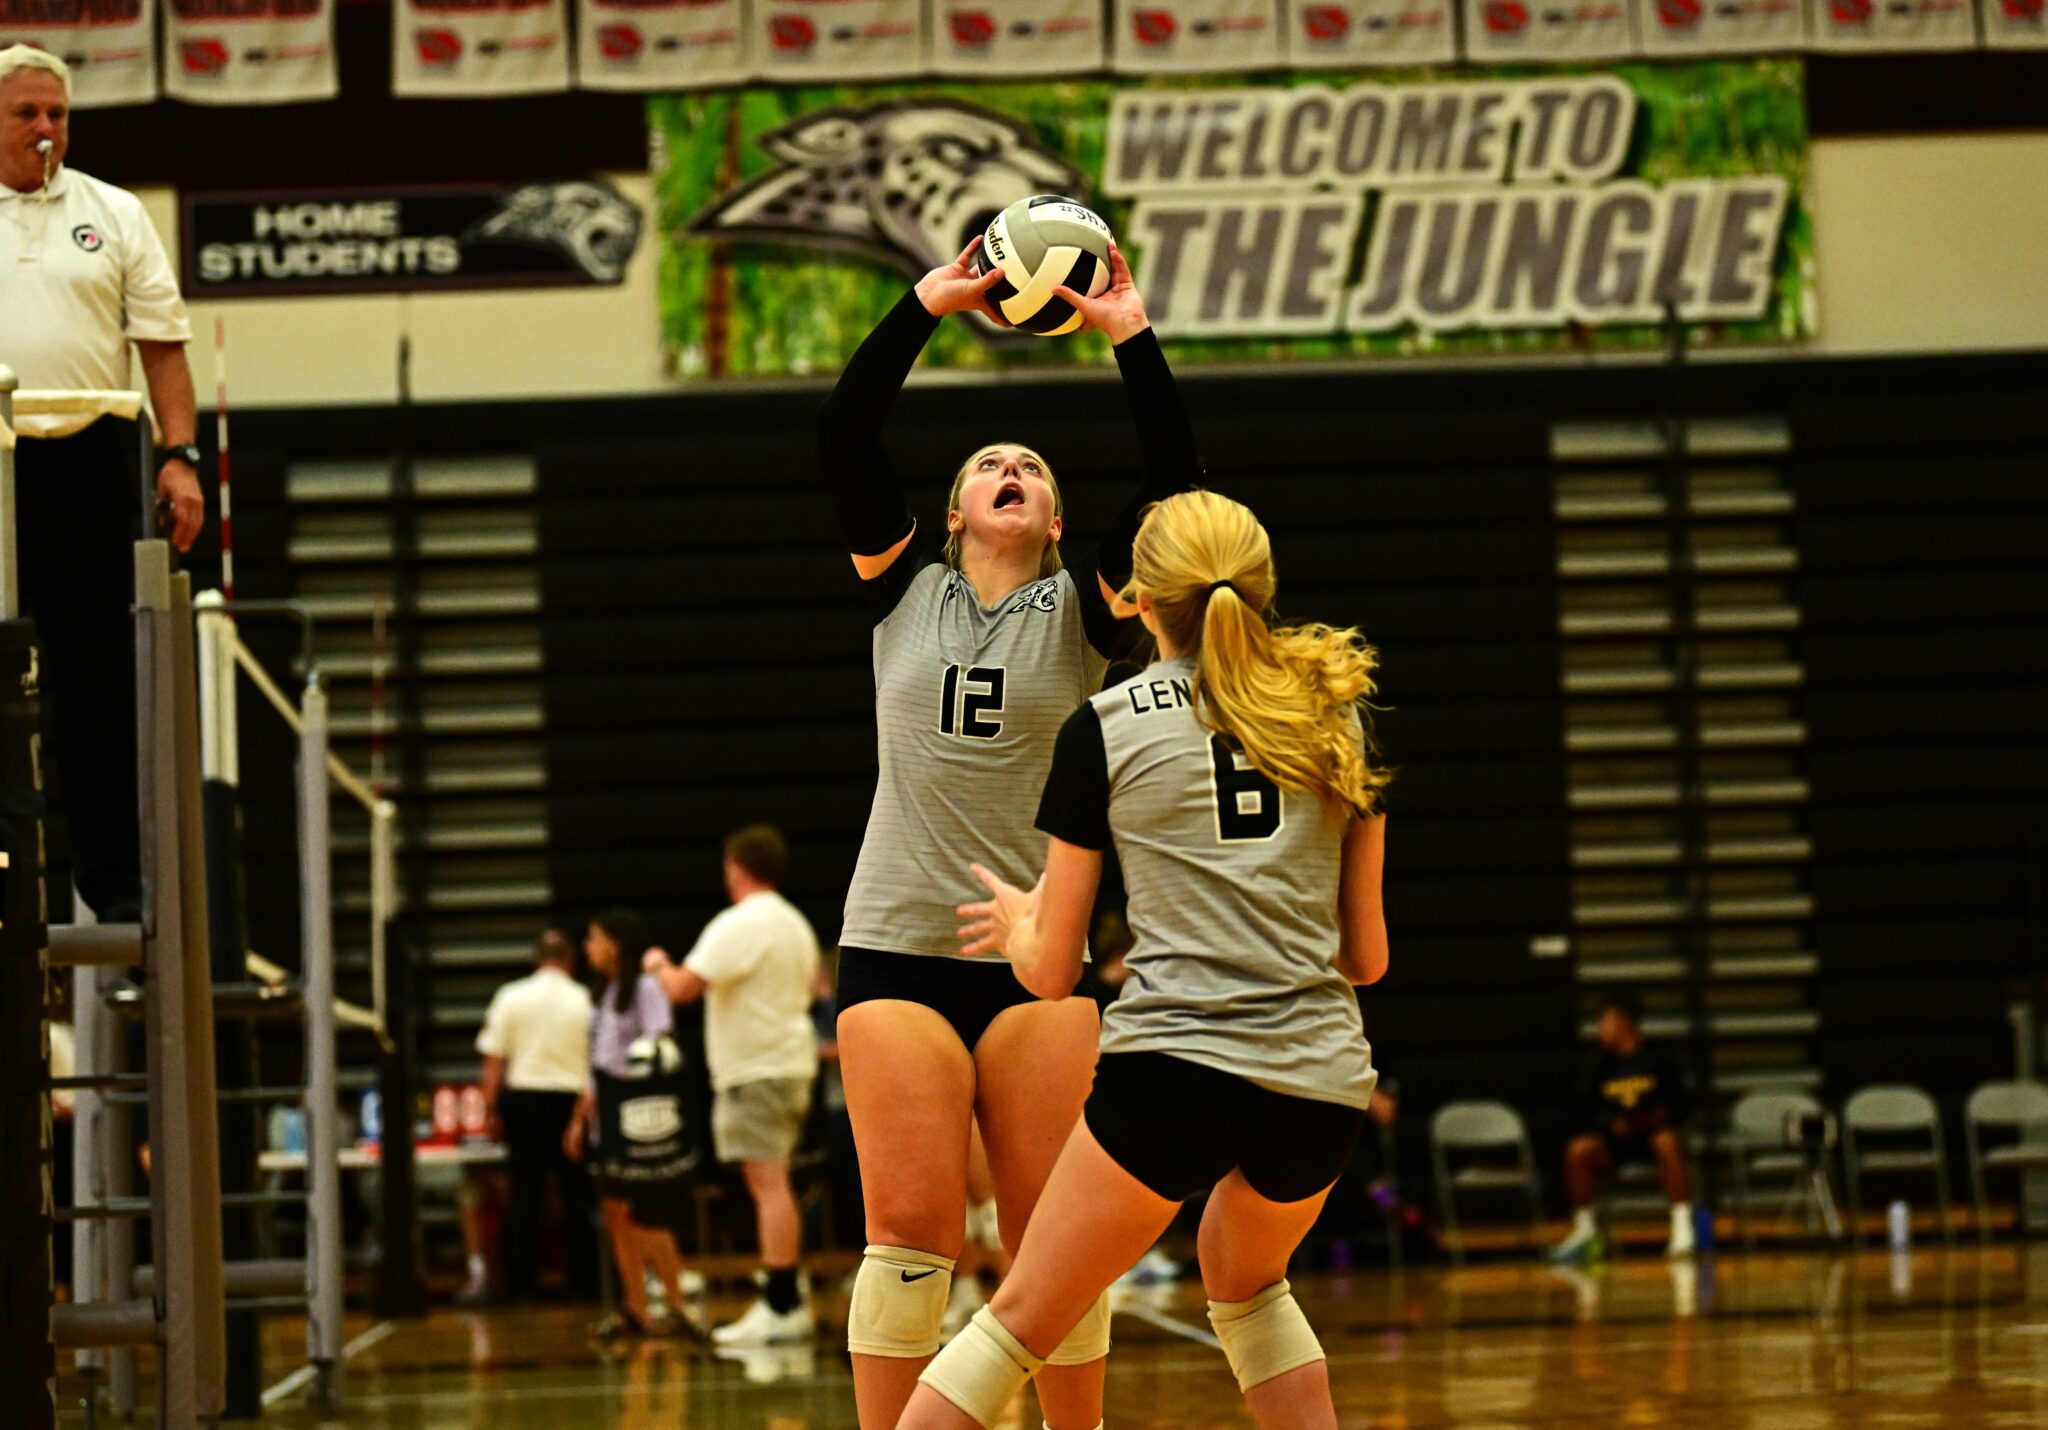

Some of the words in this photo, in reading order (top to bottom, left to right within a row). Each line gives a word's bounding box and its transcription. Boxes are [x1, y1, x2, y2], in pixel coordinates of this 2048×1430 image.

[1110, 91, 1505, 184] WELCOME
[1525, 86, 1624, 172] TO
[199, 236, 461, 281] STUDENTS
[253, 200, 400, 241] HOME
[1144, 203, 1349, 324] THE
[1356, 188, 1777, 319] JUNGLE
[938, 662, 1006, 741] 12
[1127, 677, 1195, 715] CEN
[1206, 731, 1285, 844] 6
